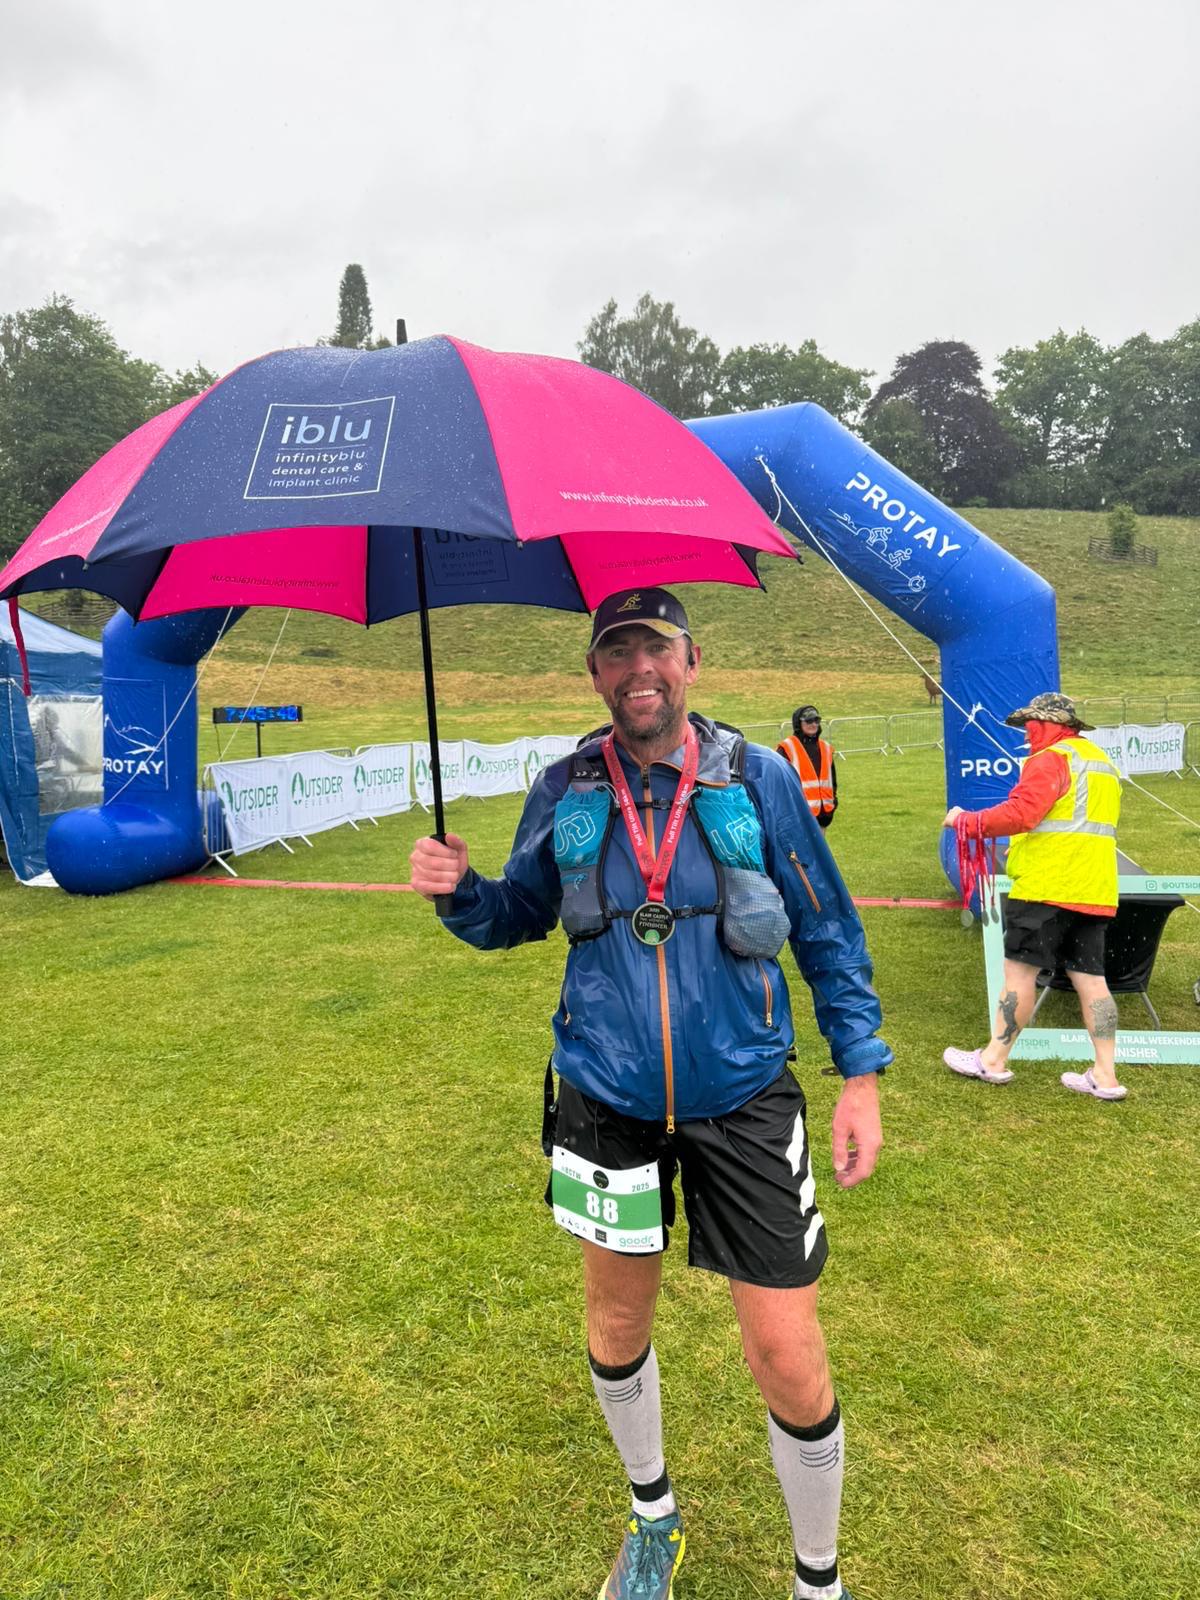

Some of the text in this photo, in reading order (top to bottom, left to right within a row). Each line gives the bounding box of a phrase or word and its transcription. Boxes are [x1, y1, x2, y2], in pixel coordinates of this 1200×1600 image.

[281, 416, 371, 444] iblu
[275, 450, 365, 464] infinityblu
[271, 462, 364, 475] dental care &
[268, 474, 360, 489] implant clinic
[845, 472, 961, 558] PROTAY
[961, 758, 1028, 777] PROT
[1061, 1034, 1086, 1043] BLAIR
[1122, 1036, 1147, 1045] TRAIL
[1114, 1047, 1159, 1058] INISHER
[632, 1182, 650, 1193] 2025
[586, 1191, 619, 1224] 88
[619, 1235, 654, 1248] goodr
